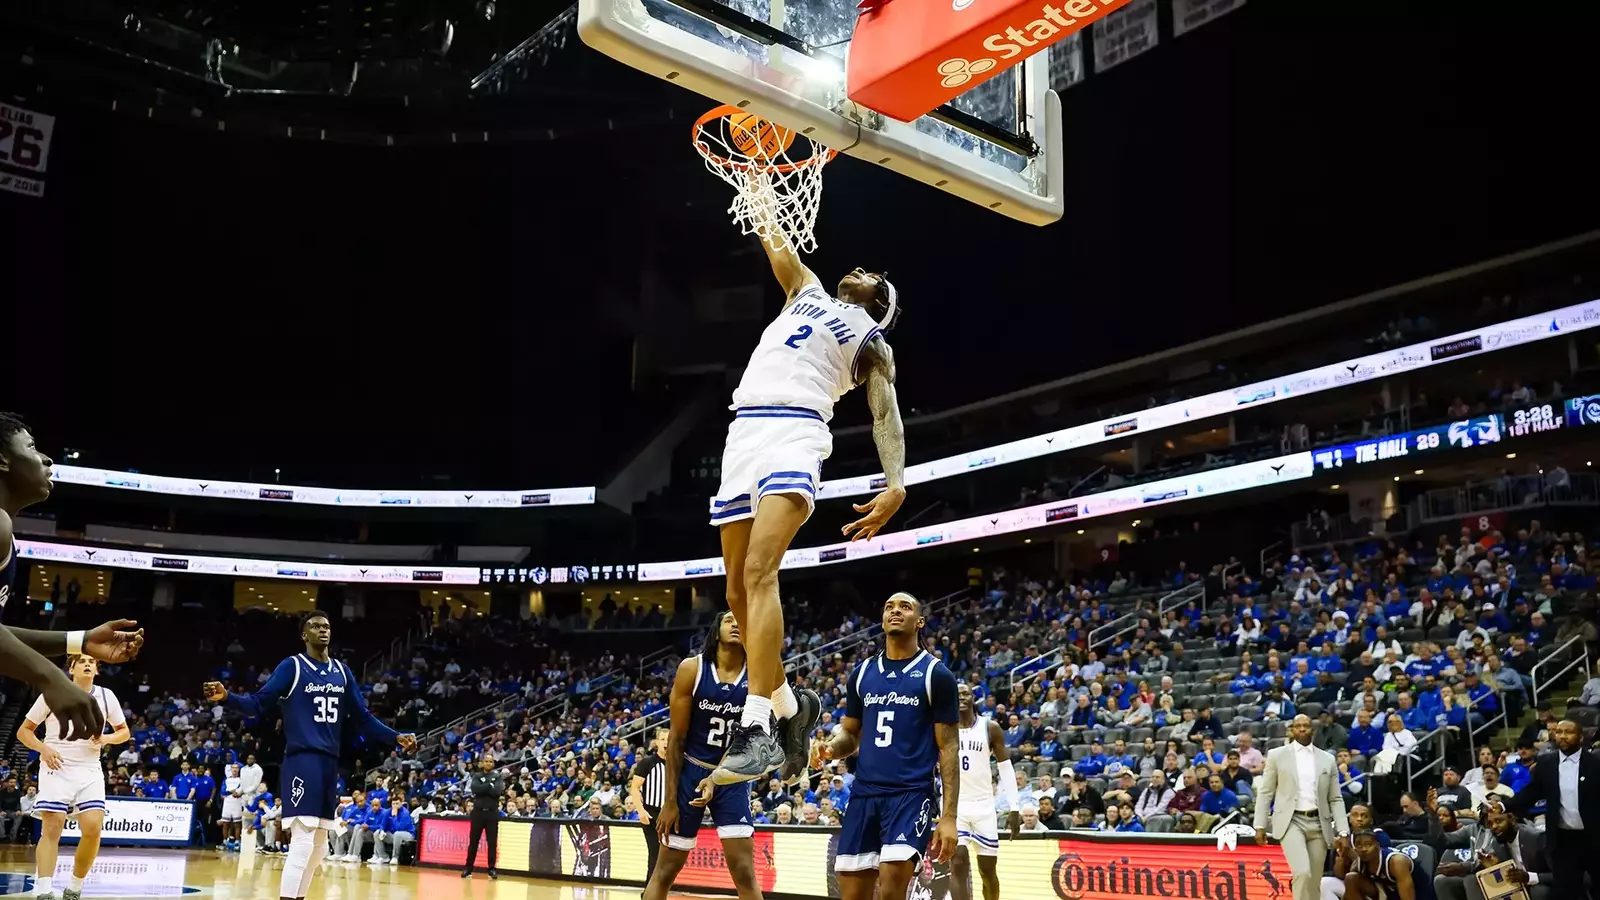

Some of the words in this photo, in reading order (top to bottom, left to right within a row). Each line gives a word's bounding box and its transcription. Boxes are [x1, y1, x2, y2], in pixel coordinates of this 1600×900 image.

[983, 0, 1098, 59] State
[791, 303, 827, 319] SETON
[824, 317, 856, 346] HALL
[784, 325, 813, 349] 2
[1509, 423, 1530, 437] 1ST
[1532, 416, 1563, 433] HALF
[1355, 444, 1378, 464] THE
[1378, 438, 1409, 460] HALL
[1478, 516, 1490, 531] 8
[304, 682, 326, 693] Saint
[863, 692, 887, 707] Saint
[886, 691, 920, 706] Peter's
[313, 696, 339, 723] 35
[698, 699, 722, 712] Saint
[874, 710, 895, 748] 5
[962, 755, 970, 771] 6
[1051, 853, 1248, 900] Continental
